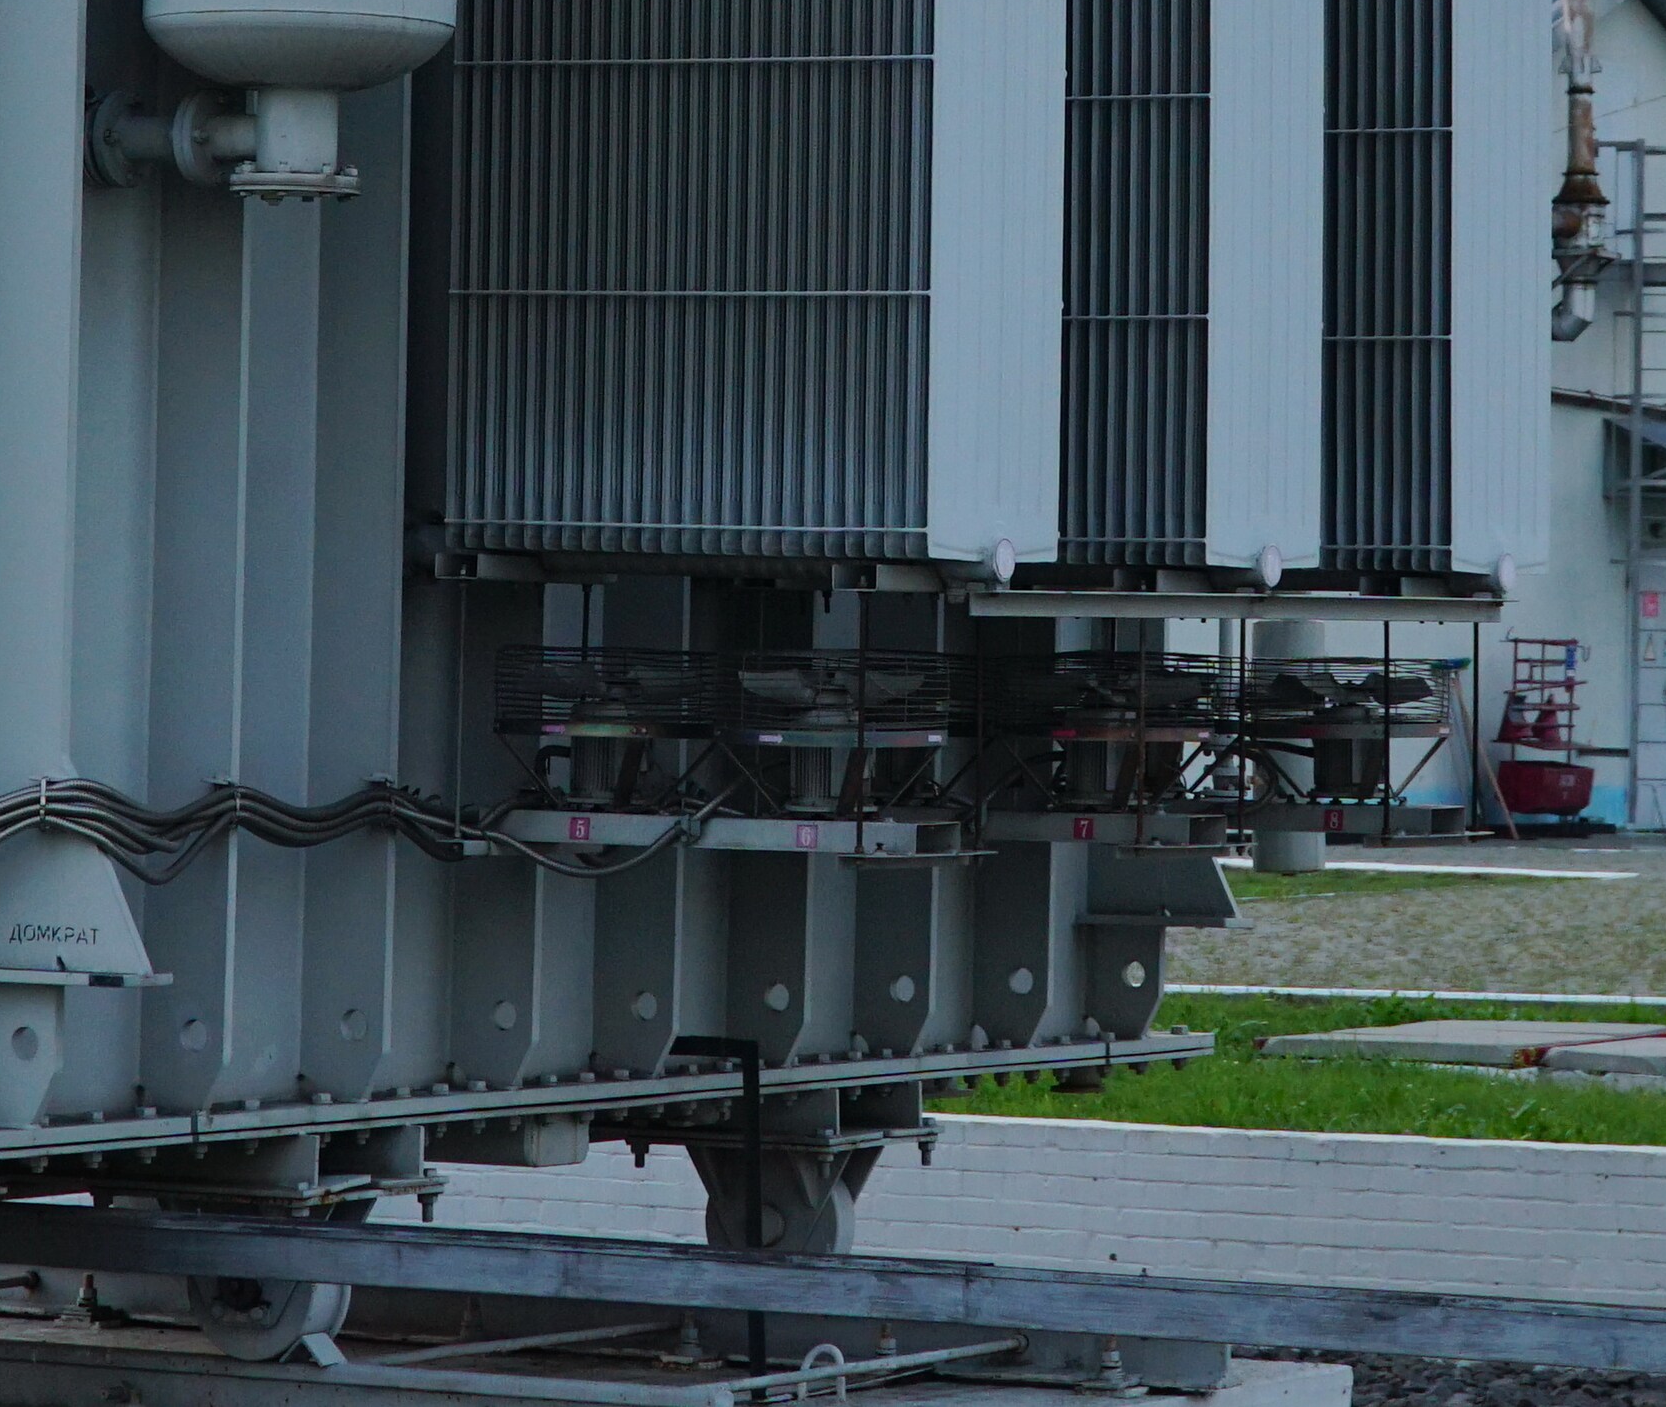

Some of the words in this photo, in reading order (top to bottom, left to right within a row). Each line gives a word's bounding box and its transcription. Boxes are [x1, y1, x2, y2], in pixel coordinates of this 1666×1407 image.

[576, 819, 584, 838] 5
[1080, 820, 1089, 838] 7
[1330, 811, 1338, 829] 8
[802, 826, 811, 846] 6
[9, 923, 99, 945] ДОМКРАТ
